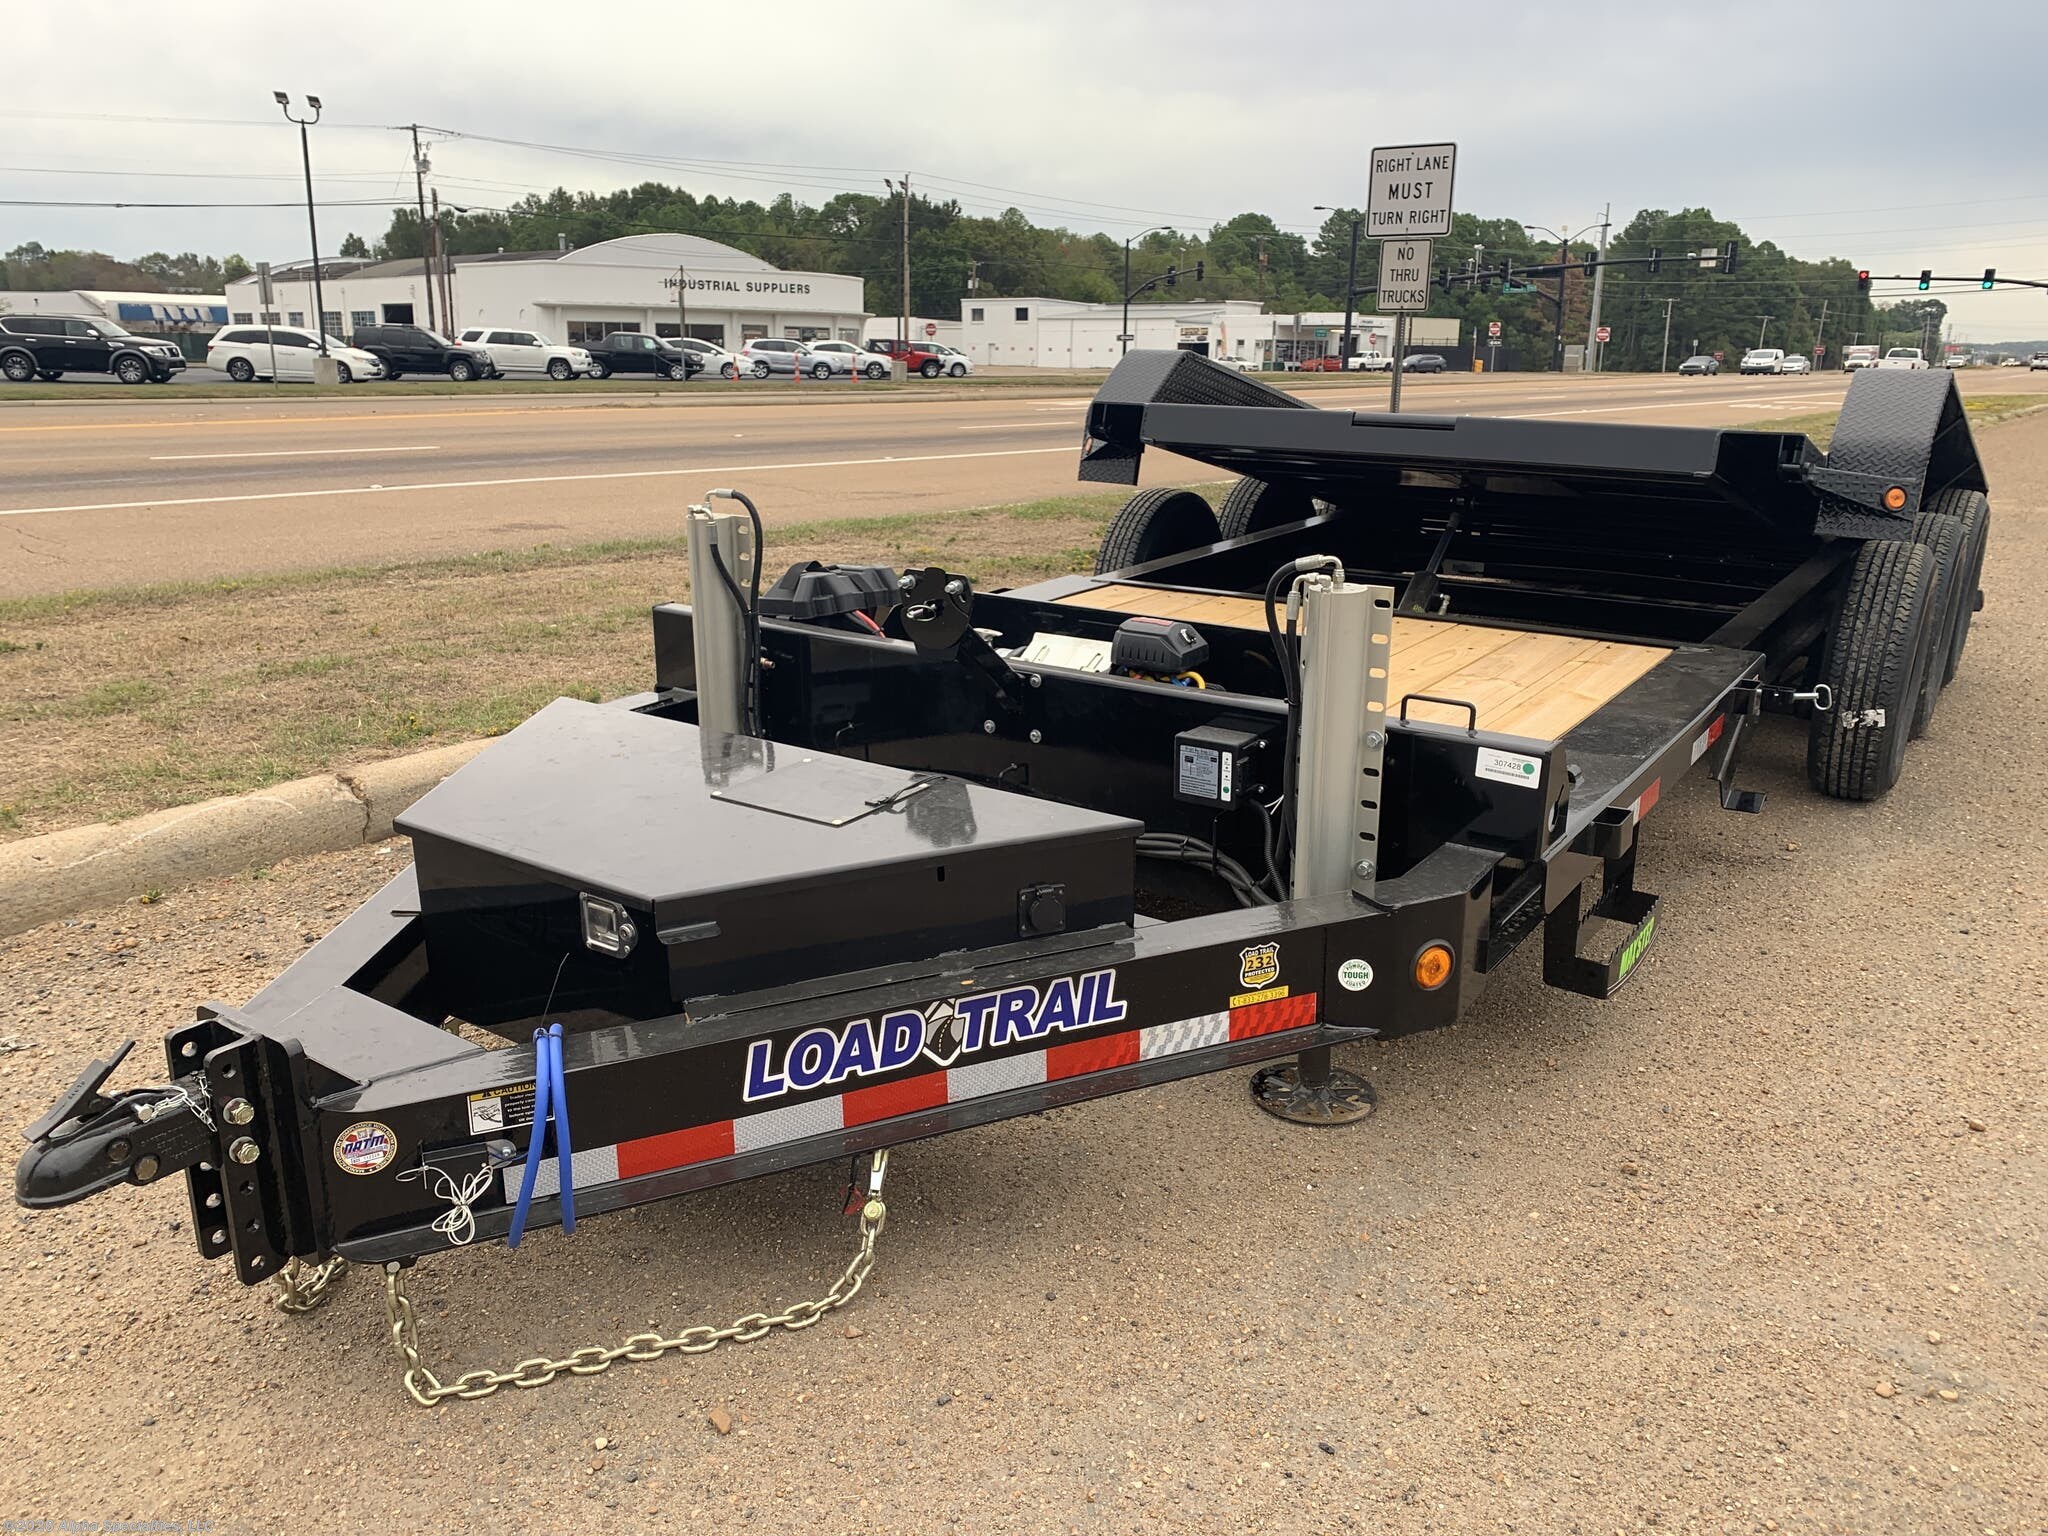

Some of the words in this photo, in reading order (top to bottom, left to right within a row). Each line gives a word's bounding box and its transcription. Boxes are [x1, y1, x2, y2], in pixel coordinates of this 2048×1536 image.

[1376, 157, 1412, 173] RIGHT
[1416, 155, 1450, 171] LANE
[1388, 181, 1434, 200] MUST
[1372, 211, 1403, 225] TURN
[1408, 209, 1447, 224] RIGHT
[1397, 247, 1415, 261] NO
[1389, 268, 1420, 282] THRU
[664, 278, 740, 292] INDUSTRIAL
[746, 281, 811, 294] SUPPLIERS
[1381, 289, 1426, 304] TRUCKS
[1494, 759, 1522, 771] 307428
[1247, 955, 1272, 970] 232
[1344, 971, 1369, 980] TOUGH
[742, 1009, 927, 1102] LOAD
[954, 968, 1128, 1054] TRAIL
